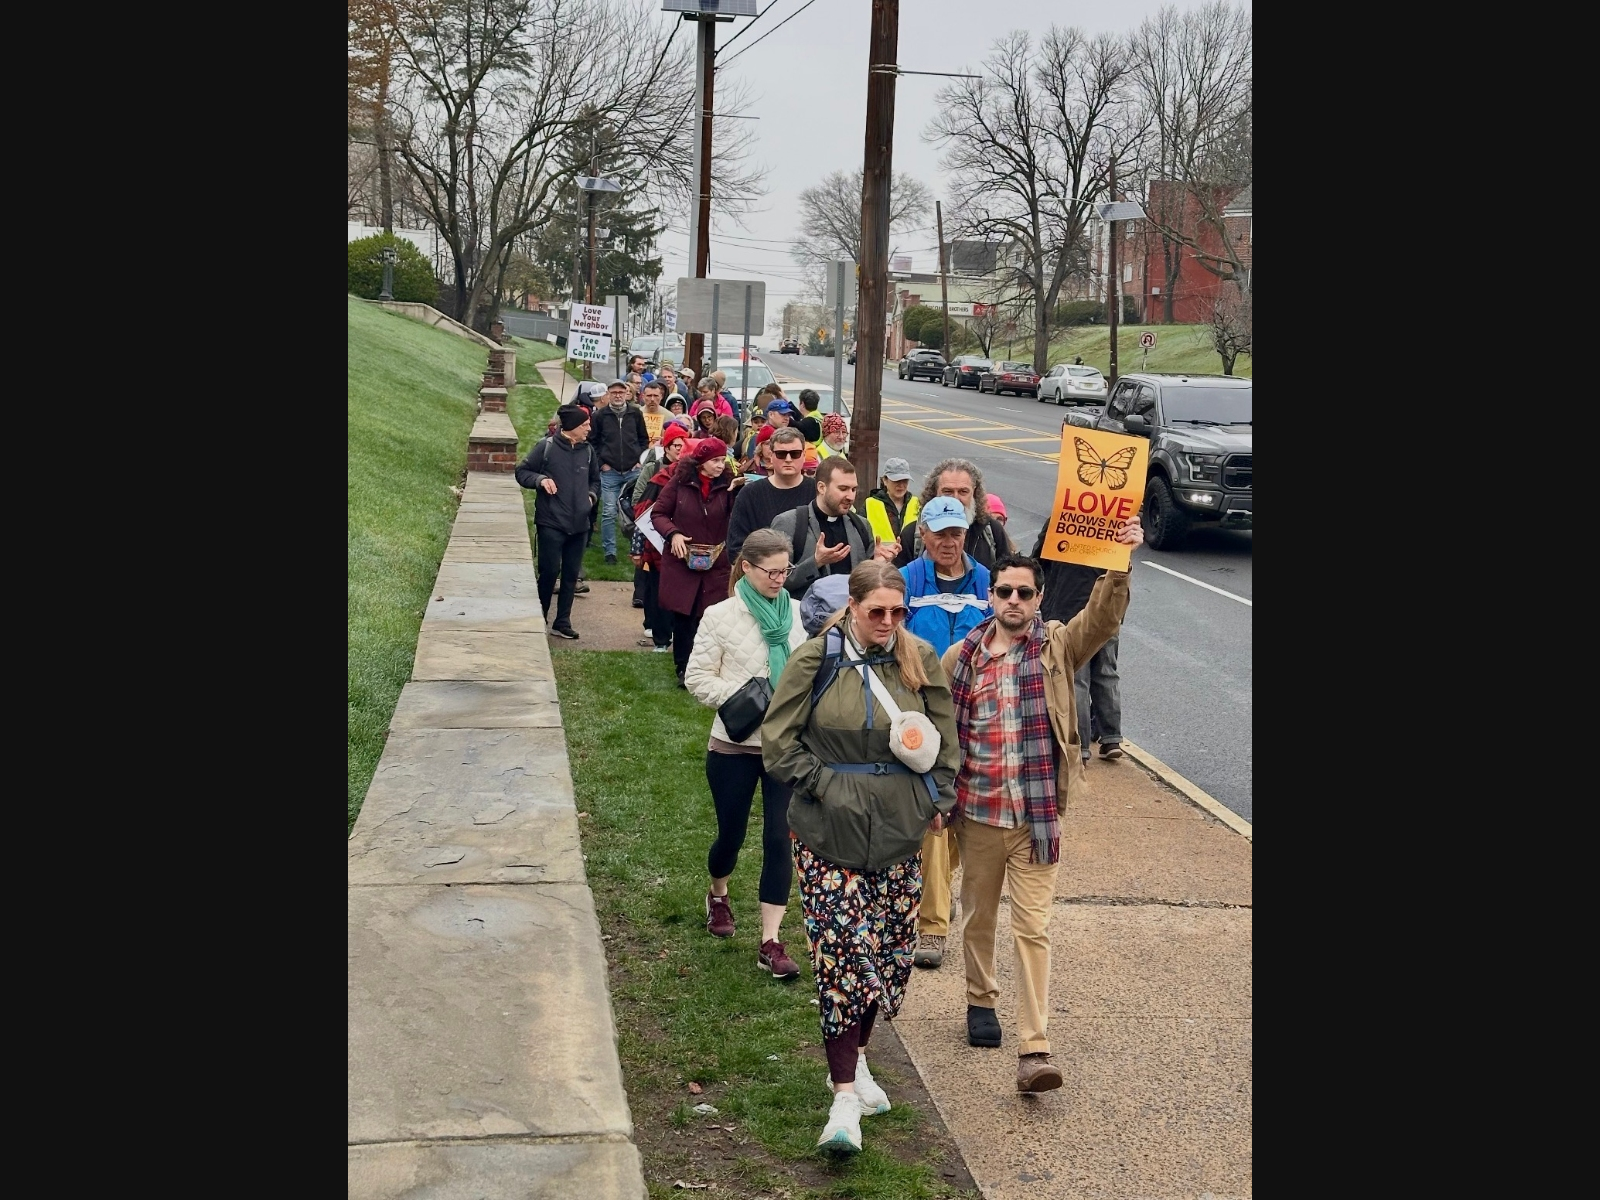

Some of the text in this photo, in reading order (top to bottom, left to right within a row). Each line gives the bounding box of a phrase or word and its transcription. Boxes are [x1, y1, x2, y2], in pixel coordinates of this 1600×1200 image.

[583, 306, 602, 315] Love
[582, 313, 601, 322] Your
[573, 319, 609, 330] Neighbor
[580, 335, 600, 345] Free
[581, 343, 596, 351] the
[572, 348, 607, 360] Captive
[644, 415, 662, 423] OVE
[1062, 488, 1134, 520] LOVE
[1059, 511, 1127, 530] KNOWS NO
